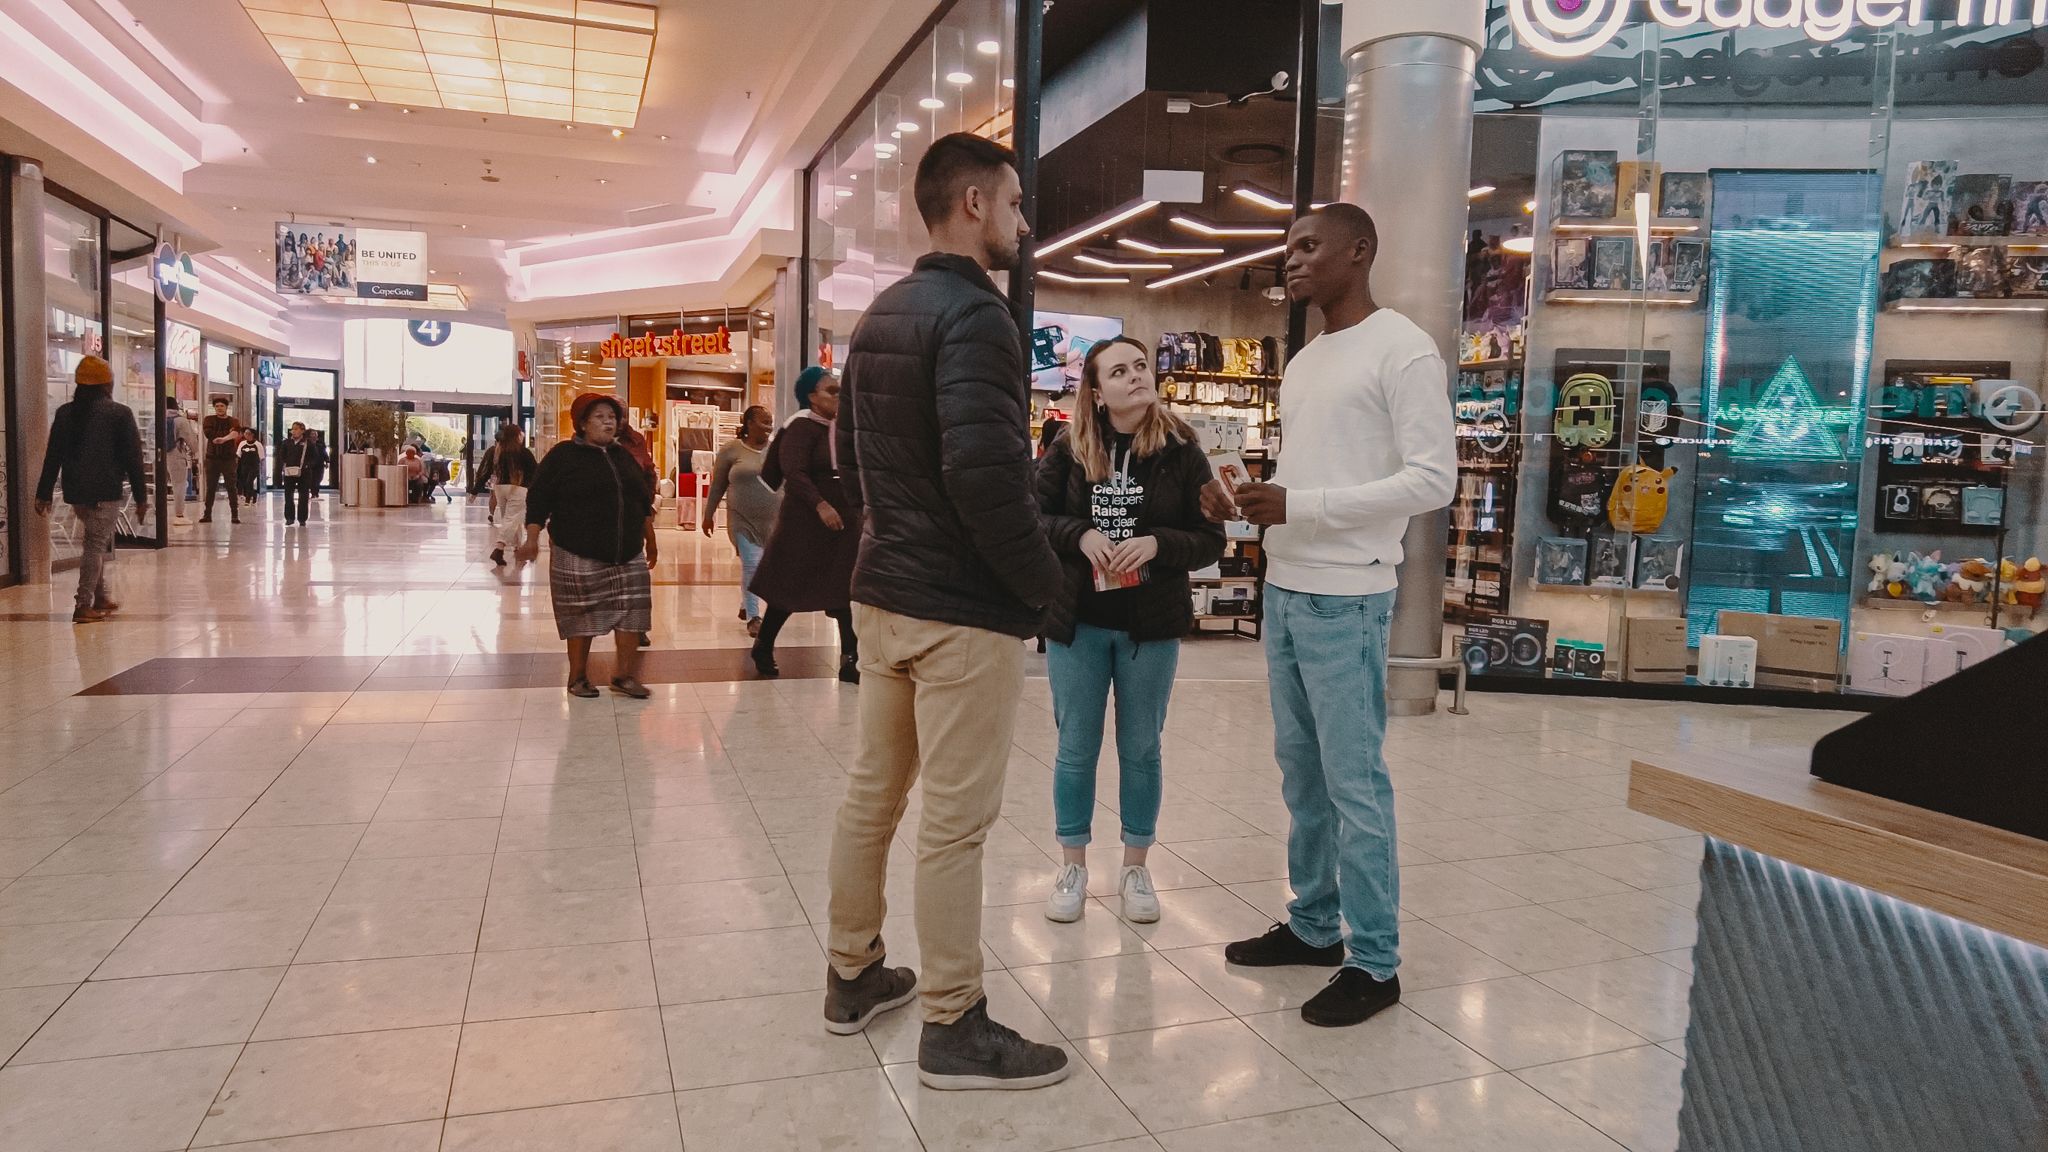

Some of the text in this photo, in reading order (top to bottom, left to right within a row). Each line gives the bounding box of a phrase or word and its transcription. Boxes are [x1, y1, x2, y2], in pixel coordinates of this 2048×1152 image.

[361, 250, 417, 260] BE UNITED
[371, 285, 415, 297] CapeGate
[417, 320, 440, 341] 4
[600, 325, 731, 358] sheet street
[1092, 484, 1144, 495] Cleanse
[1091, 494, 1109, 505] the
[1092, 505, 1127, 516] Raise
